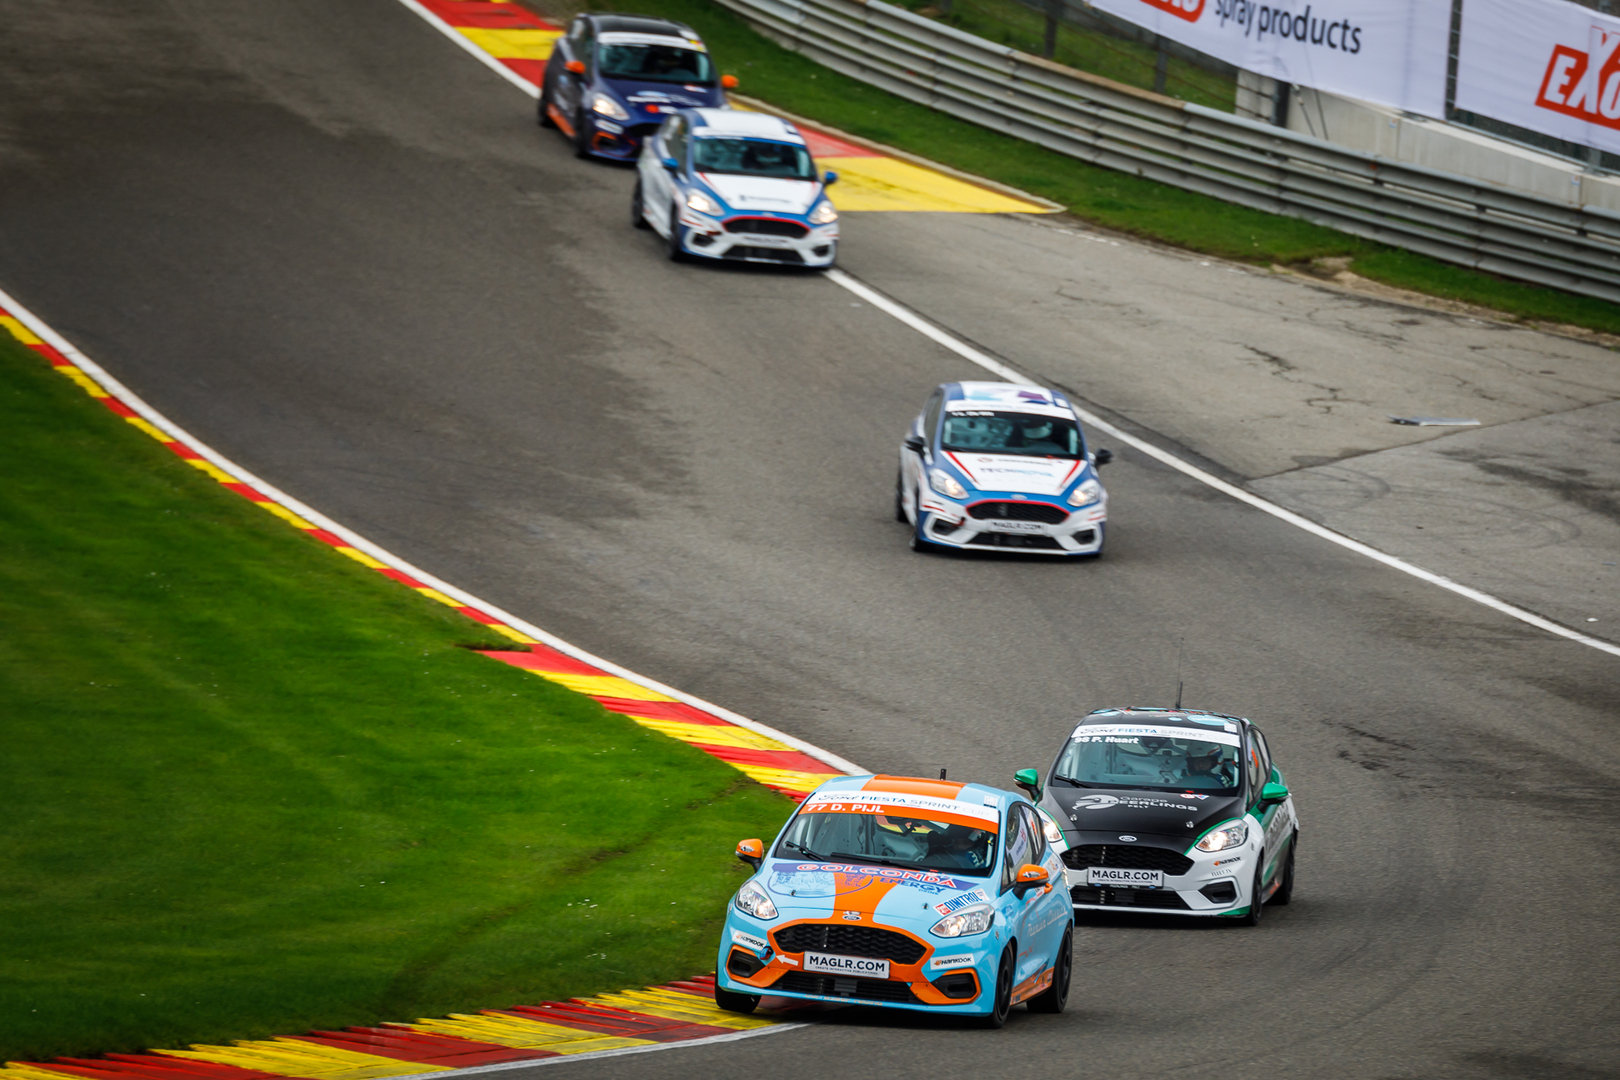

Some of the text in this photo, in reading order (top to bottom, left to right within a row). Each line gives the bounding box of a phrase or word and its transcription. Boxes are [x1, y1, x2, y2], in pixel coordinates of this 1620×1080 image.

[1215, 0, 1362, 54] spray products
[1160, 729, 1206, 738] SPRINT
[807, 804, 885, 813] 77 D. PIJL
[861, 795, 907, 804] FIESTA
[910, 799, 961, 811] SPRINT
[796, 863, 957, 889] GOLCONDA
[1092, 870, 1159, 881] MAGLR.COM
[879, 877, 948, 893] ENERGY
[918, 888, 939, 896] DRINK
[943, 891, 983, 912] DINITROL
[809, 955, 885, 972] MAGLR.COM
[940, 957, 972, 965] HANKOOK
